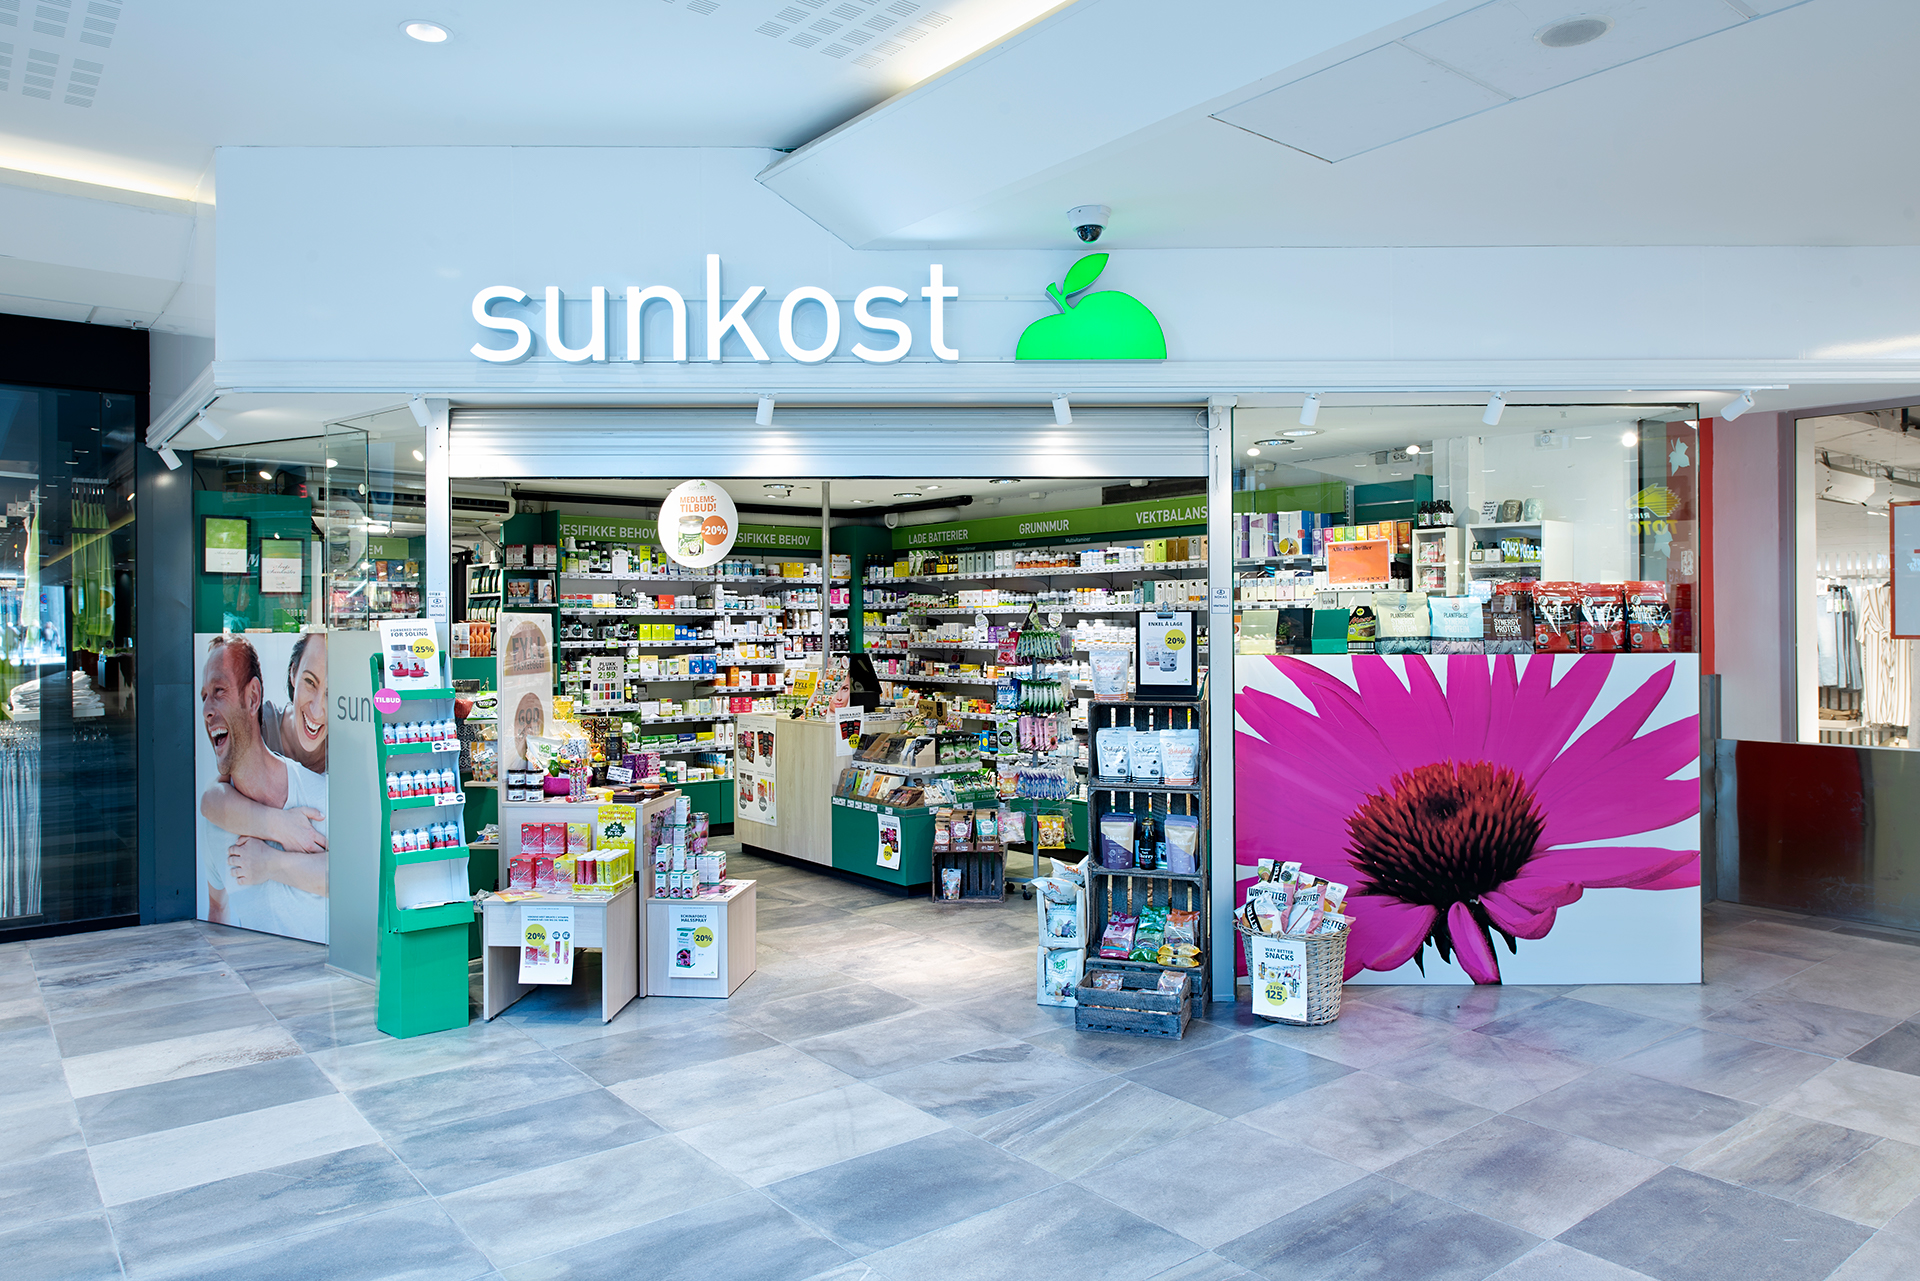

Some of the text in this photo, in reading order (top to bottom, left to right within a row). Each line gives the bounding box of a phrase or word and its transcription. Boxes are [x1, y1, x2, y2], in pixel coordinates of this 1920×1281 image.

[470, 253, 959, 364] sunkost
[680, 495, 717, 504] MEDLEMS-
[680, 503, 717, 513] TILBUD!
[619, 526, 657, 539] BEHOV
[701, 525, 727, 535] -20%
[1019, 519, 1070, 535] GRUNNMUR
[778, 534, 811, 546] BEHOV
[908, 529, 969, 545] LADE BATTERIER
[1493, 618, 1519, 626] SYNERGY
[1494, 625, 1521, 633] PROTEIN
[337, 695, 371, 722] sun
[518, 707, 540, 726] GOD
[525, 932, 546, 940] -20%
[1264, 951, 1295, 962] SNACKS
[1265, 989, 1288, 1002] 125,-
